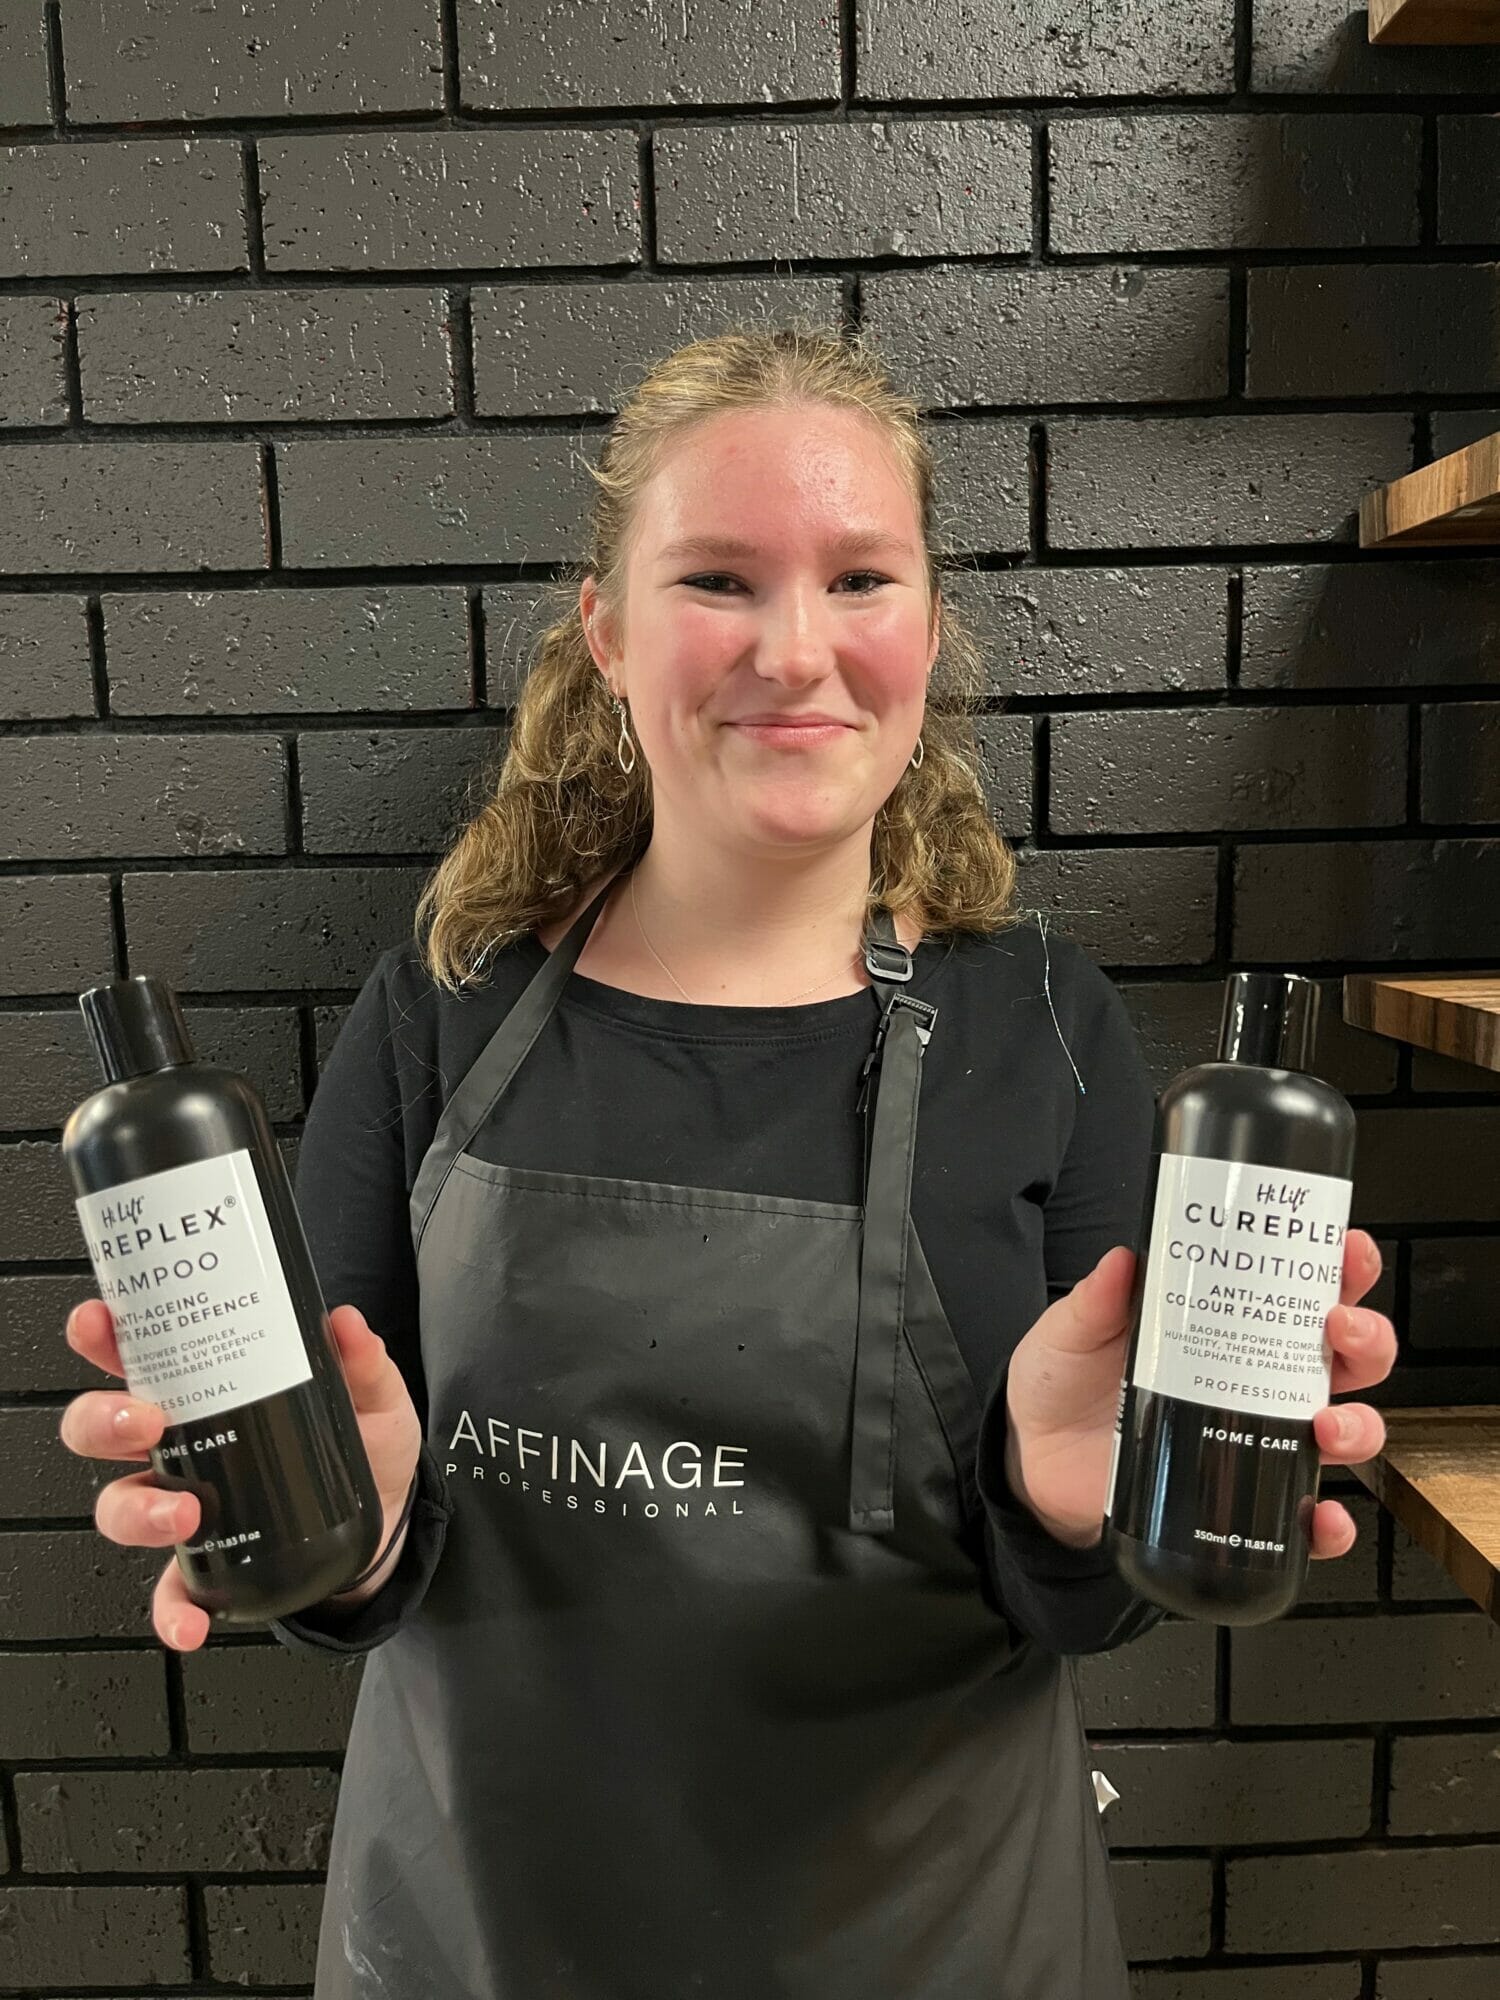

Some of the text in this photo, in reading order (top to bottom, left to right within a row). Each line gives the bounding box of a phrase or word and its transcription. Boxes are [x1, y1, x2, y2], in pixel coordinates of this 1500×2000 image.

[1257, 1184, 1310, 1213] Hi Lift
[1185, 1203, 1344, 1246] CUREPLEX
[1166, 1292, 1325, 1329] COLOUR FADE DEFE
[1210, 1284, 1320, 1312] ANTI-AGEING
[135, 1320, 173, 1340] FADE
[177, 1291, 260, 1328] DEFENCE
[143, 1346, 177, 1361] POWER
[180, 1327, 236, 1351] COMPLEX
[182, 1354, 190, 1363] &
[193, 1348, 208, 1360] UV
[212, 1329, 266, 1354] DEFENCE
[1189, 1324, 1325, 1353] BAOBAB POWER COMPLE
[1226, 1342, 1279, 1360] THERMAL
[1283, 1351, 1289, 1360] &
[1292, 1350, 1305, 1362] UV
[163, 1359, 214, 1381] PARABEN
[217, 1348, 247, 1365] FREE
[1183, 1345, 1323, 1376] SULPHATE & PARABEN FREE
[155, 1381, 238, 1411] ESSIONAL
[1193, 1375, 1311, 1404] PROFESSIONAL
[159, 1430, 238, 1460] OME CARE
[449, 1410, 748, 1490] AFFINAGE
[1202, 1426, 1299, 1451] HOME CARE
[446, 1463, 744, 1518] PROFESSIONAL
[1193, 1529, 1227, 1545] 350ml
[1244, 1538, 1265, 1551] 11.83
